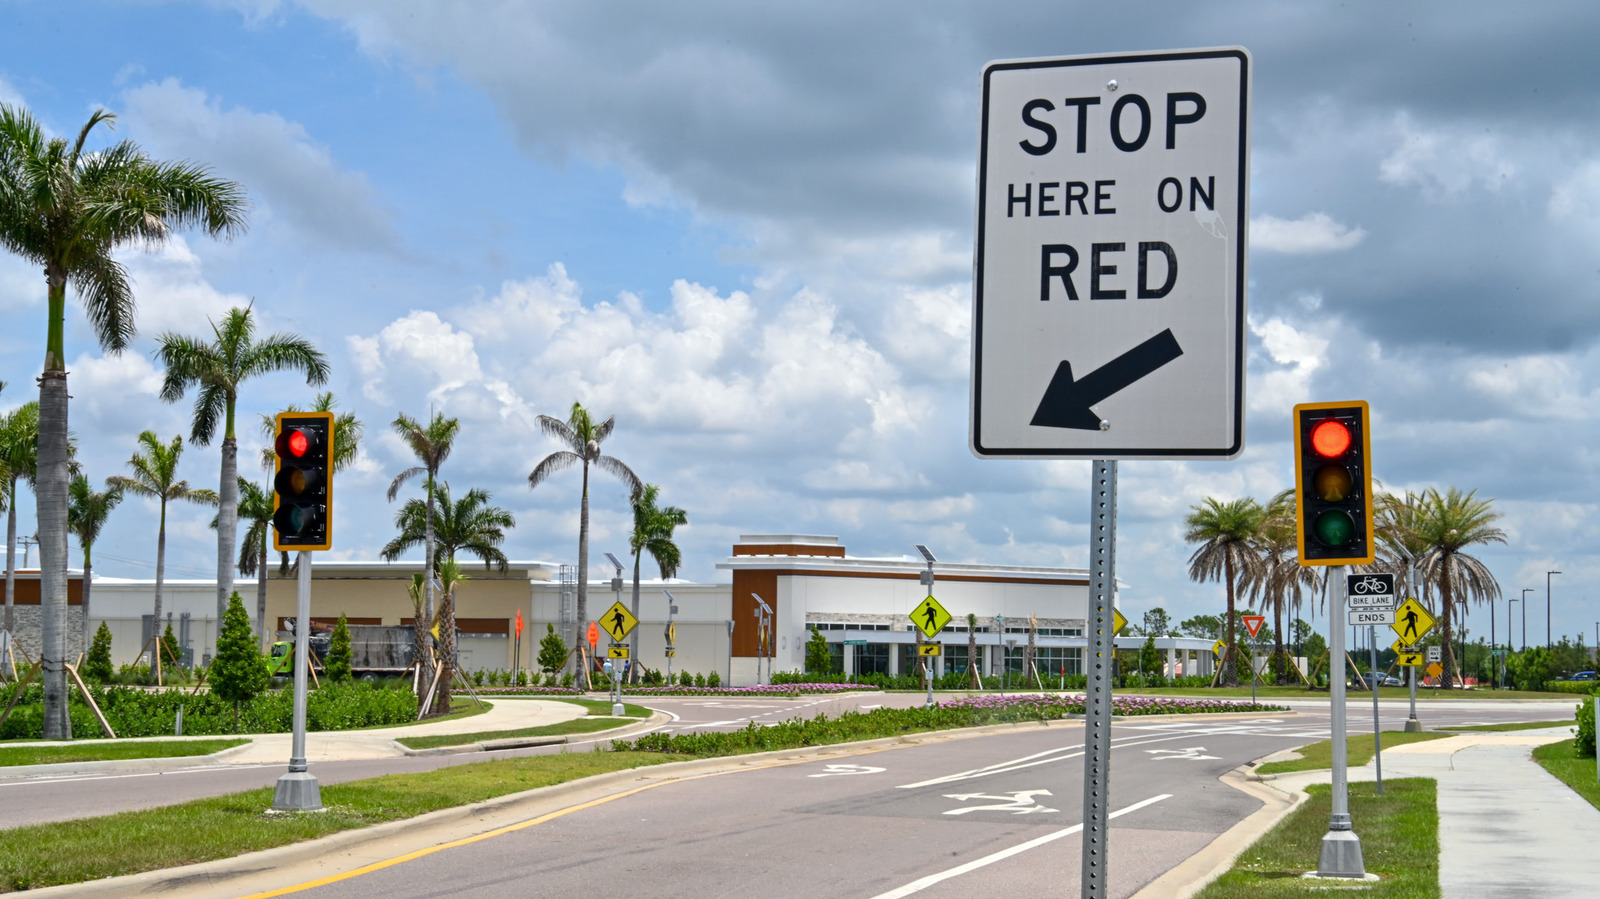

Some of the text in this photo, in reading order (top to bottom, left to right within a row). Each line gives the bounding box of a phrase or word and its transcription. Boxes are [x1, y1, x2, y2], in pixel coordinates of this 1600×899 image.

[1019, 92, 1207, 156] STOP
[1007, 176, 1215, 218] HERE ON
[1040, 241, 1178, 301] RED
[1353, 596, 1390, 605] BIKE LANE
[1358, 614, 1385, 622] ENDS
